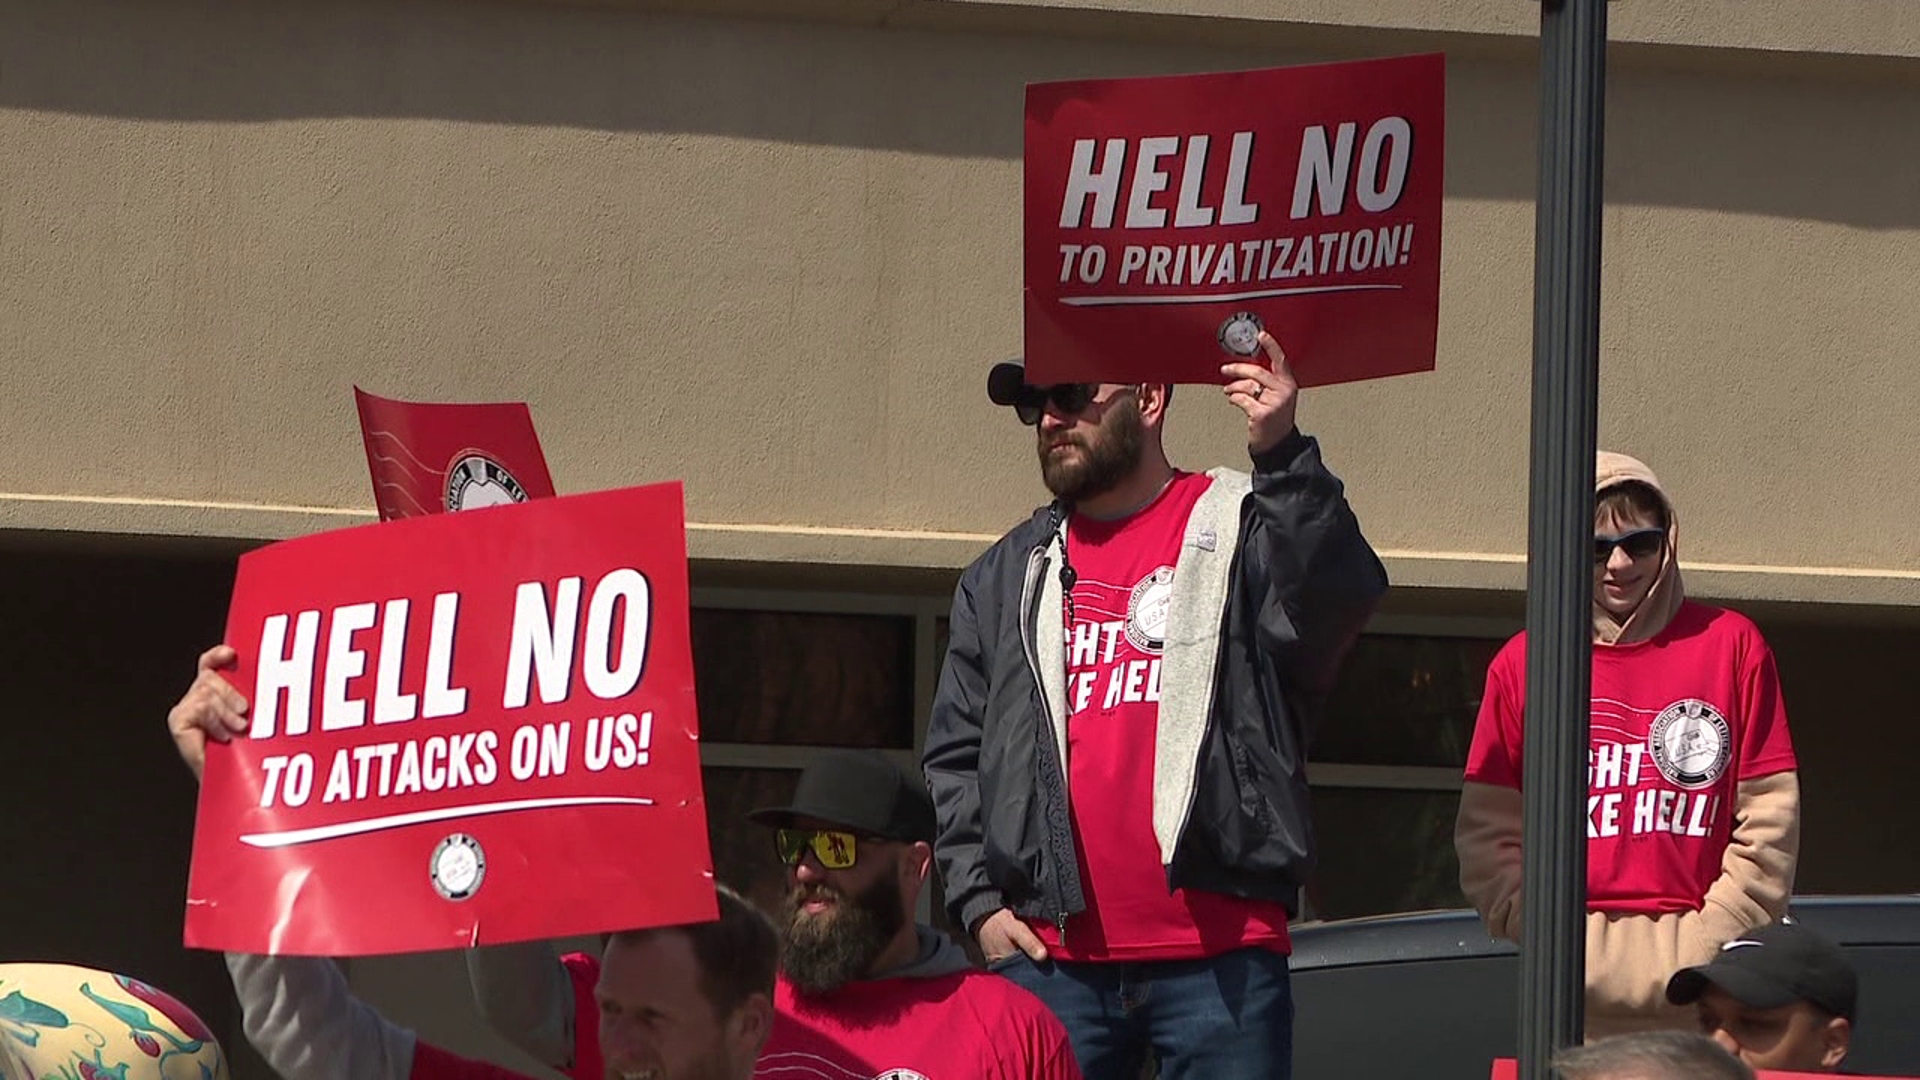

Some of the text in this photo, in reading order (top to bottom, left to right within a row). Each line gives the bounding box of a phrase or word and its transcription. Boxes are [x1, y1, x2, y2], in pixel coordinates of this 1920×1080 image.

[1059, 116, 1412, 229] HELL NO
[1060, 224, 1414, 285] TO PRIVATIZATION!
[250, 568, 650, 739] HELL NO
[260, 711, 652, 809] TO ATTACKS ON US!
[1633, 789, 1719, 838] HELL!
